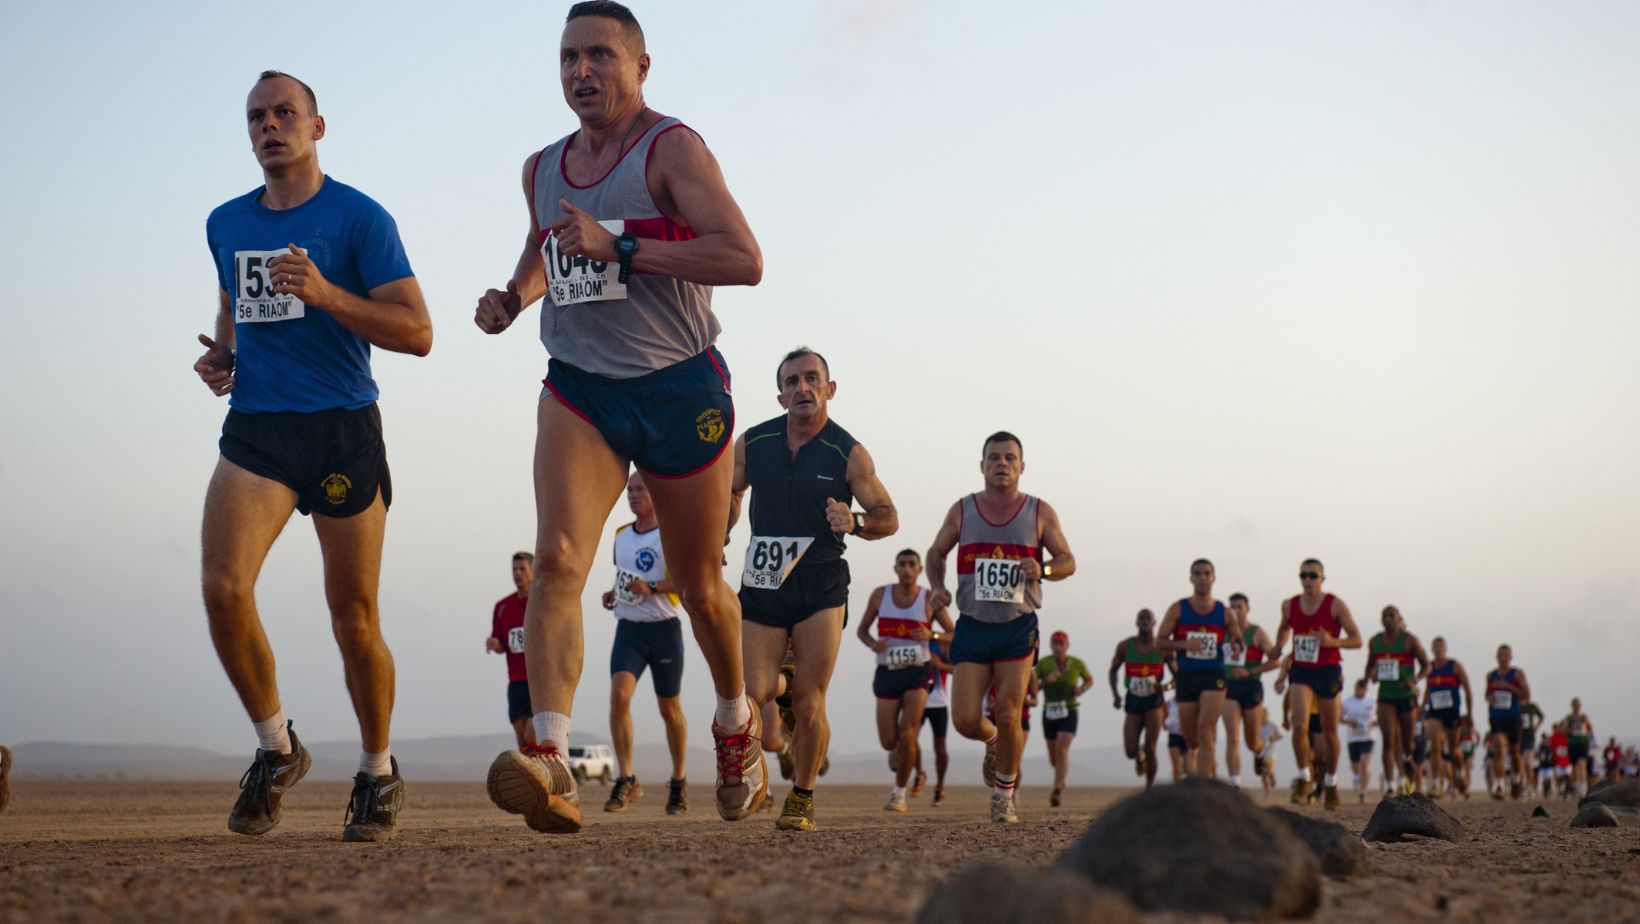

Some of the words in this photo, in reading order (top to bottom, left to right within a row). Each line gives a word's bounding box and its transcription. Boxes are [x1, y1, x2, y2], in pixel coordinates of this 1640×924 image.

[752, 541, 798, 572] 691
[977, 561, 1020, 588] 1650
[889, 648, 917, 665] 1159
